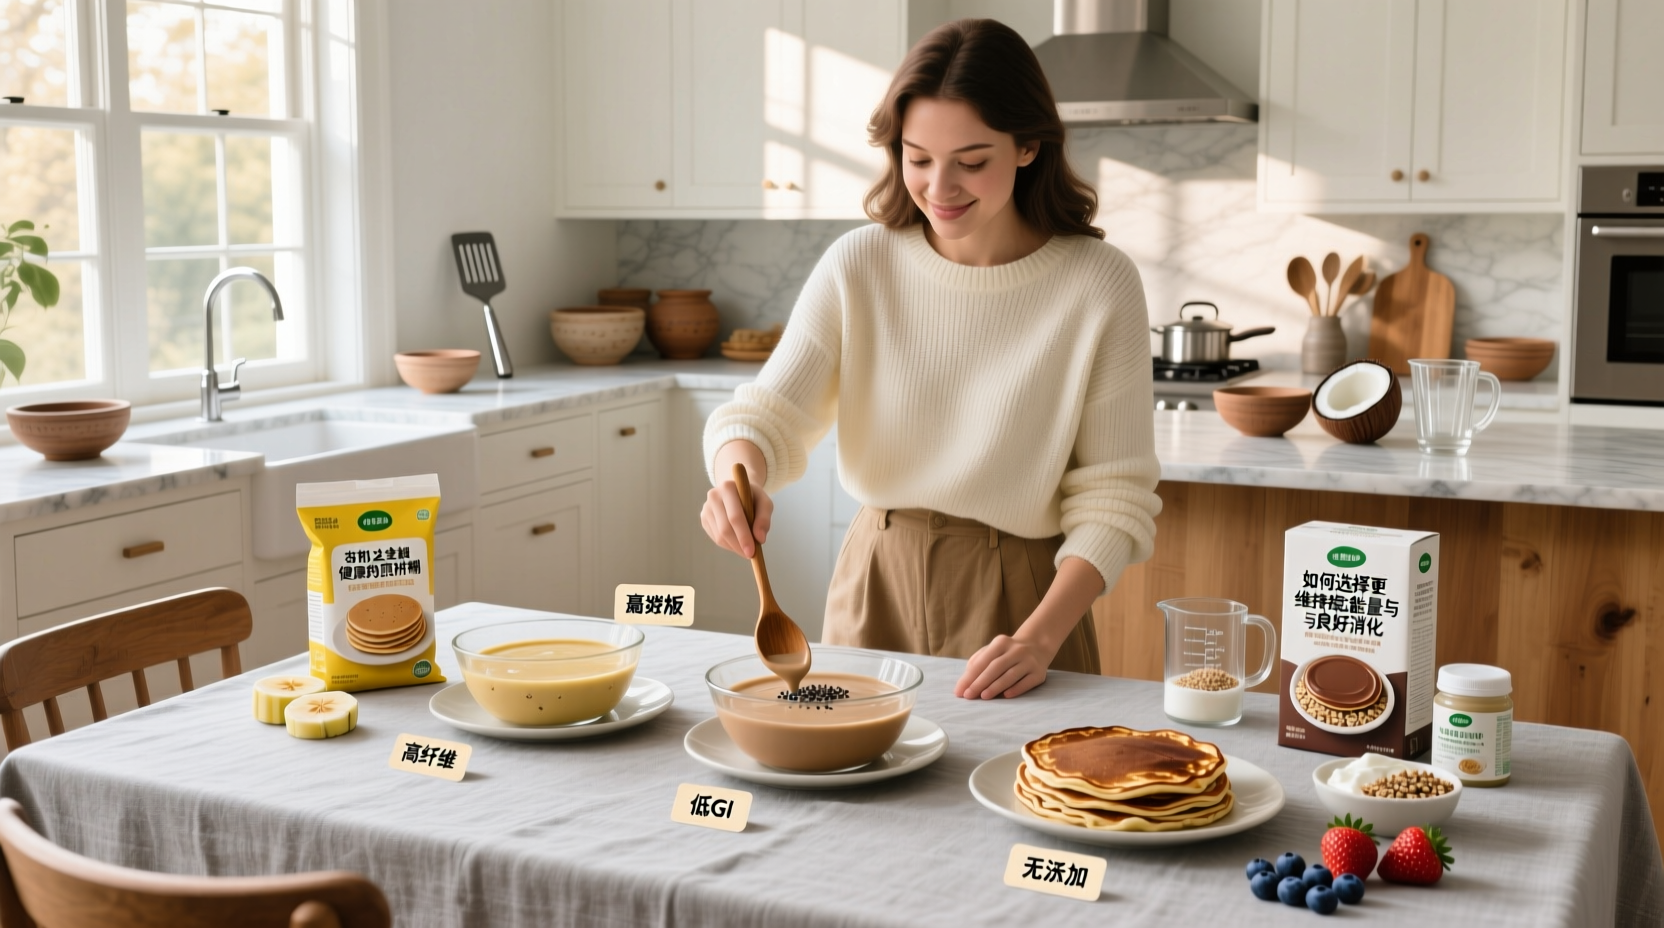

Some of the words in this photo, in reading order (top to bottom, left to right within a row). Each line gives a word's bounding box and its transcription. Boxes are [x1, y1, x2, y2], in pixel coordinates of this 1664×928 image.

[1302, 569, 1388, 596] 如何选择更
[1303, 612, 1384, 638] 与良好消化
[401, 742, 457, 769] 高纤维
[690, 793, 734, 819] 低GI
